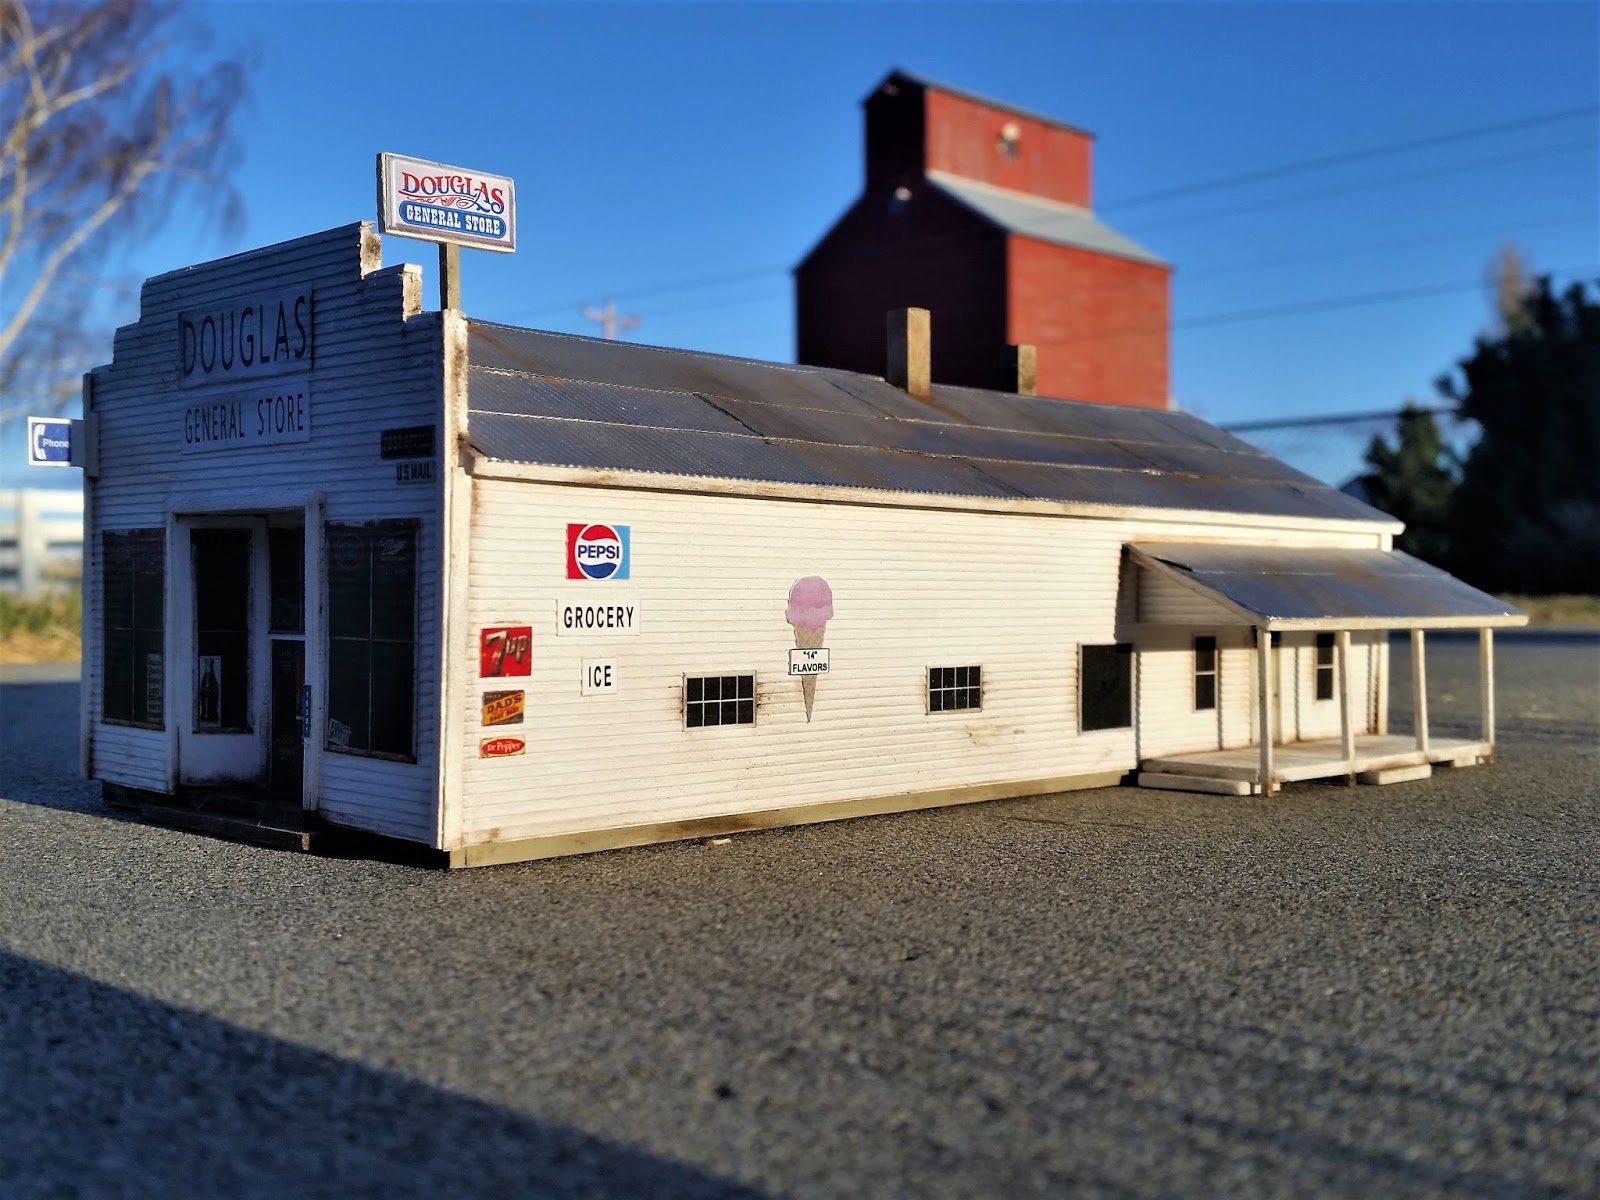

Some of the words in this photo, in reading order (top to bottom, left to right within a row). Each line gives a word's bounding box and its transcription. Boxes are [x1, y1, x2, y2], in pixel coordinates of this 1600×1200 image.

[401, 172, 505, 214] DOUGLAS
[406, 204, 462, 228] GENERAL
[465, 215, 501, 235] STORE
[182, 295, 306, 377] DOUGLAS
[184, 402, 245, 444] GENERAL
[257, 393, 304, 436] STORE
[42, 438, 70, 448] Phone
[577, 544, 620, 559] PEPSI
[563, 606, 635, 629] GROCERY
[588, 665, 612, 688] ICE
[792, 662, 828, 673] FLAVORS
[487, 743, 496, 752] Dr
[496, 741, 521, 753] Pepper
